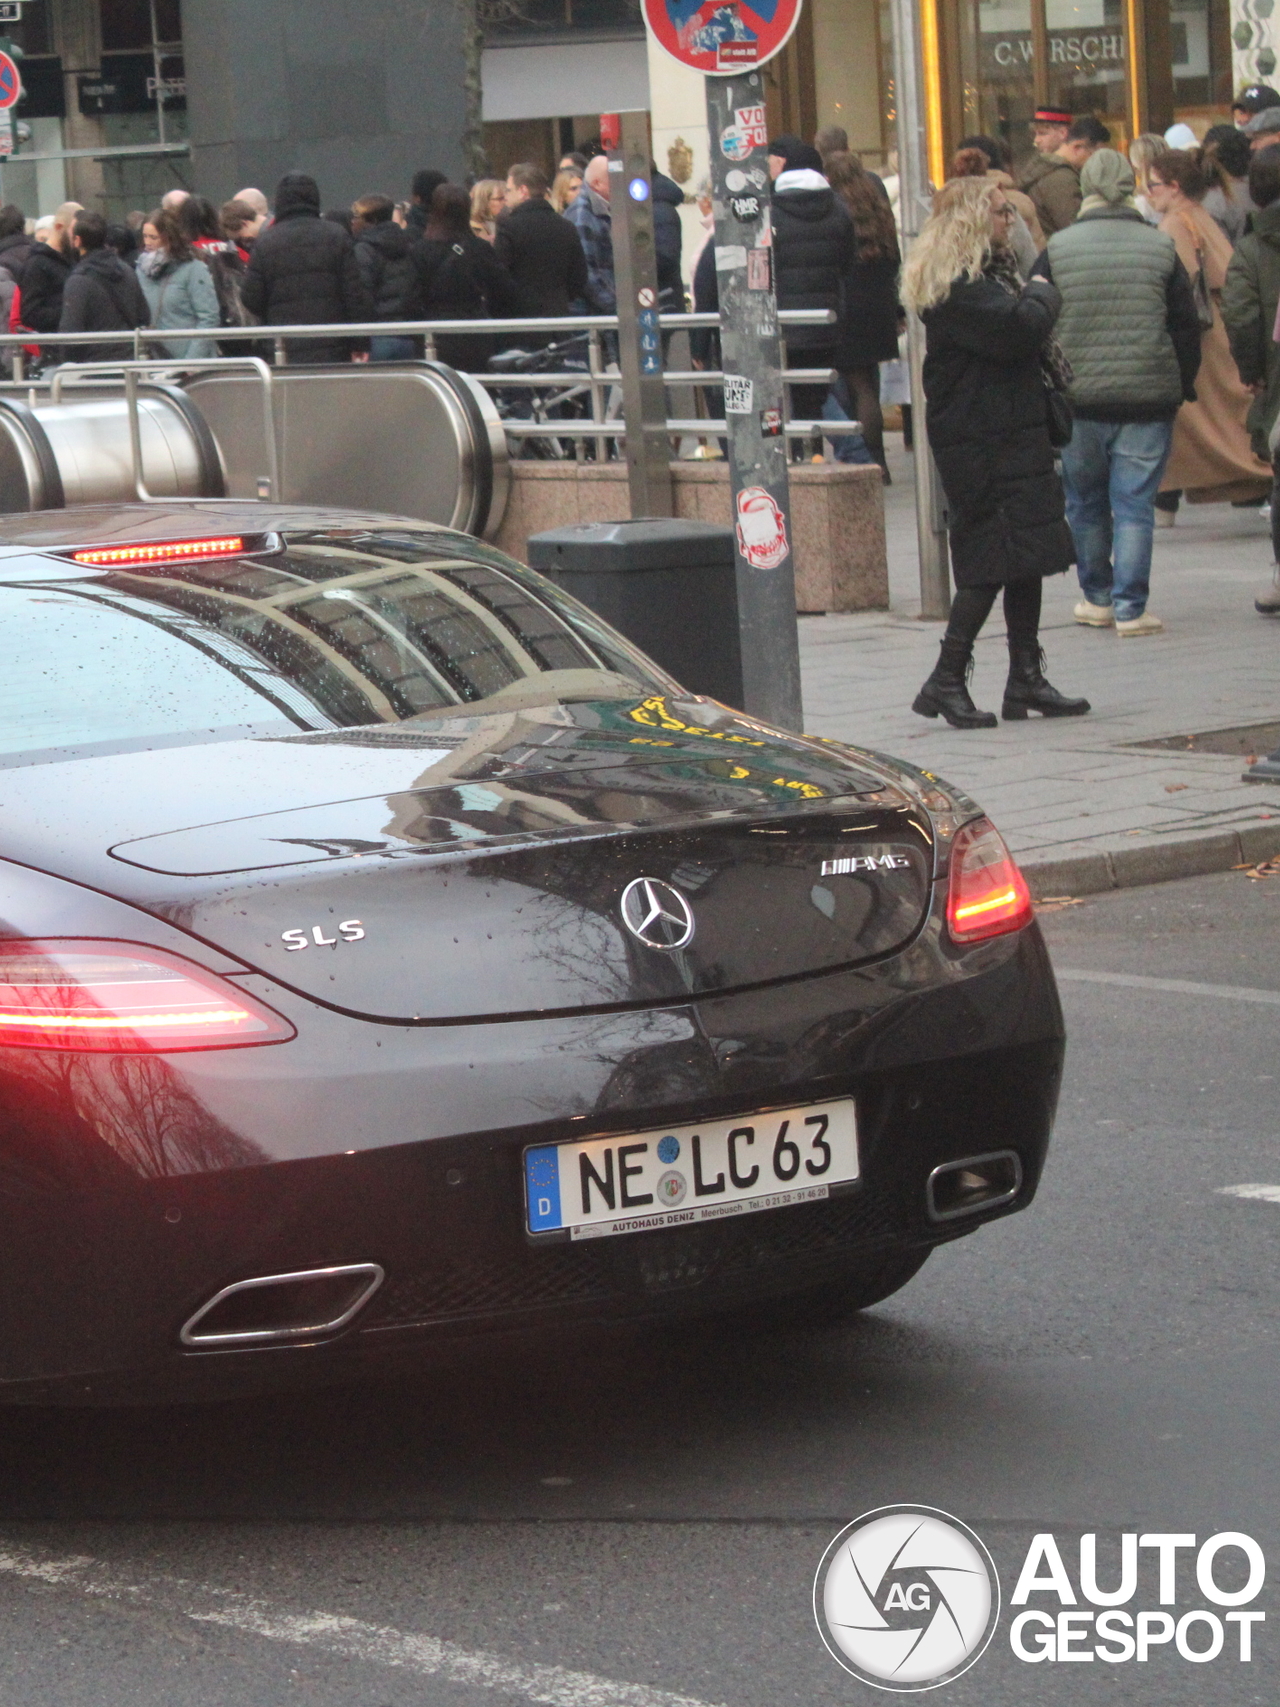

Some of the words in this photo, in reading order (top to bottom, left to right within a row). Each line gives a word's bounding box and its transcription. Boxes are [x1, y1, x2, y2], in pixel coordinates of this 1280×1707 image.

[281, 920, 365, 951] SLS
[579, 1143, 654, 1213] NE
[691, 1126, 760, 1197] LC
[772, 1114, 831, 1181] 63
[537, 1197, 551, 1216] D
[612, 1217, 665, 1233] AUTOHAUS
[667, 1211, 695, 1225] DENIZ
[701, 1204, 743, 1218] Meerbusch
[748, 1200, 764, 1210] Tel.:
[765, 1198, 771, 1207] 0
[782, 1194, 791, 1204] 32
